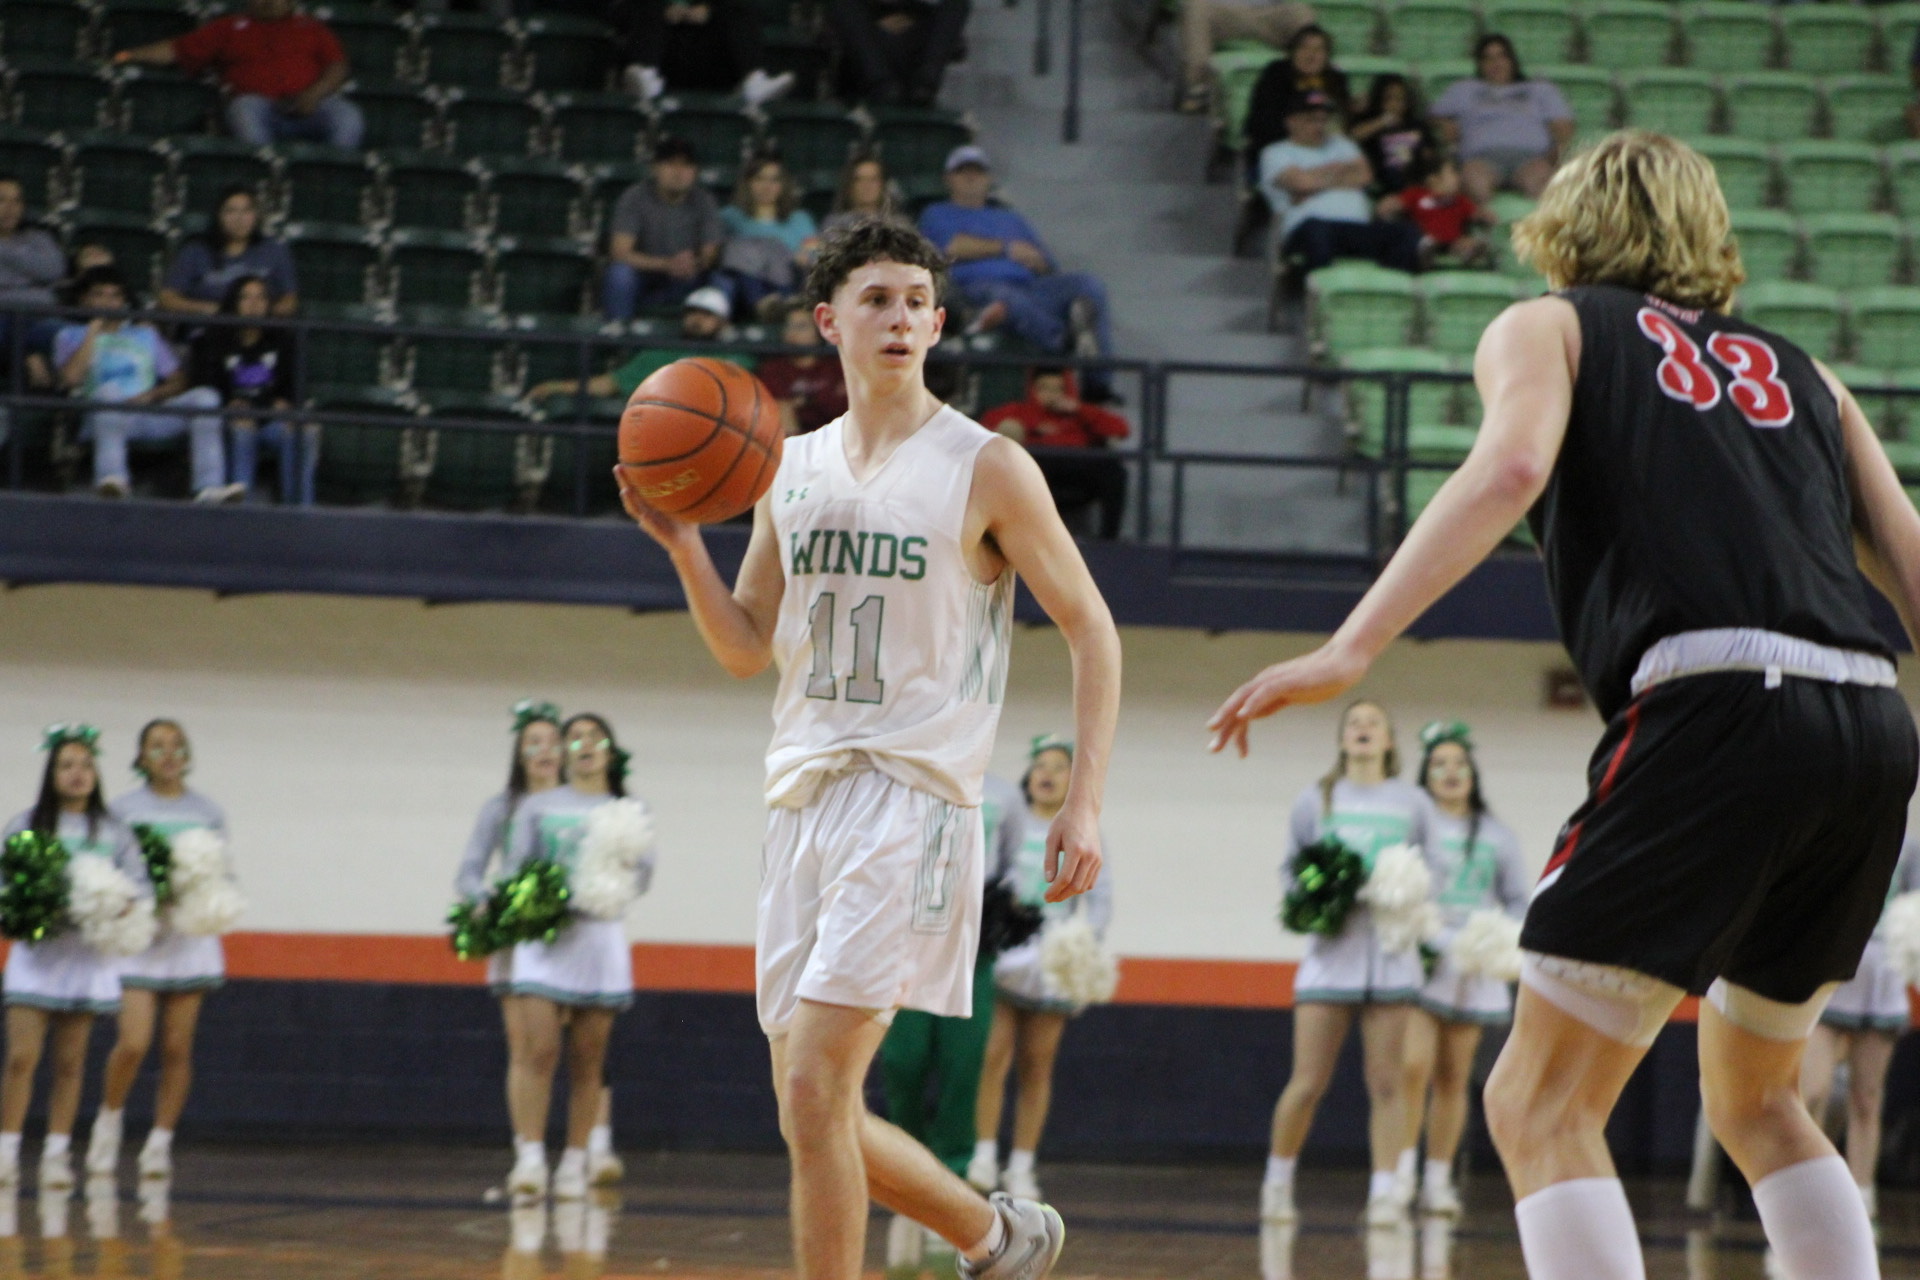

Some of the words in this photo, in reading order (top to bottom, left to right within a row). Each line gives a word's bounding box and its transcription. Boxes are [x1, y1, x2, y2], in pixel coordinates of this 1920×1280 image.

[1637, 307, 1794, 428] 33
[791, 530, 928, 580] WINDS
[806, 592, 884, 704] 11
